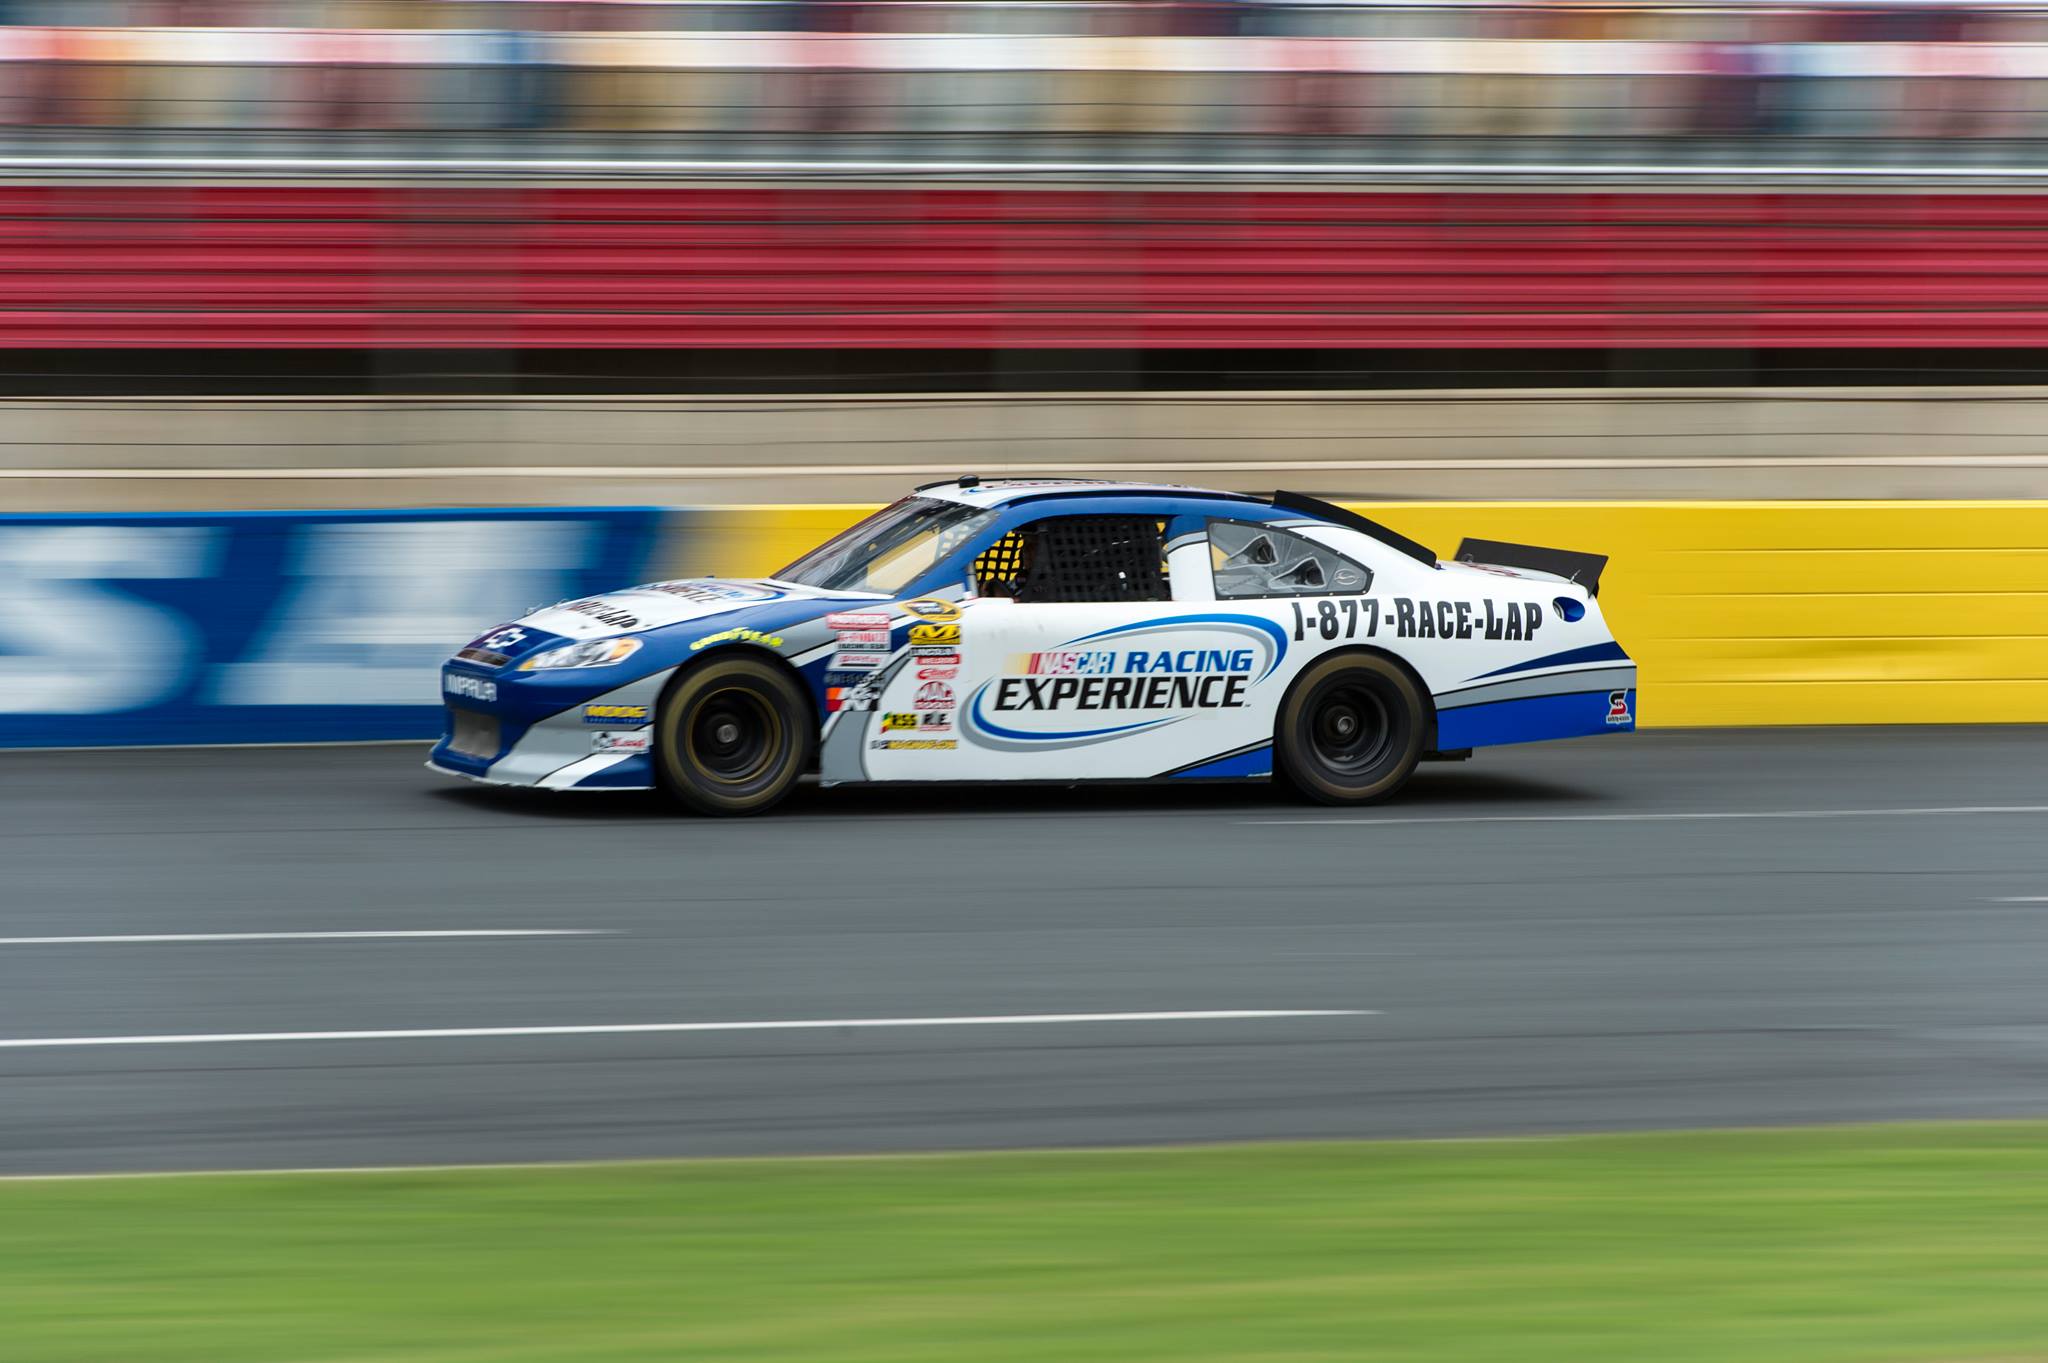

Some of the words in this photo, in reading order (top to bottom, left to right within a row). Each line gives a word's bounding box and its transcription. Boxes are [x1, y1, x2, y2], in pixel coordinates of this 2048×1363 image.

[1292, 596, 1543, 642] 1-877-RACE-LAP
[689, 626, 784, 651] GOODYEAR
[1029, 651, 1116, 675] NASCAR
[1123, 650, 1254, 674] RACING
[994, 675, 1249, 711] EXPERIENCE
[585, 705, 649, 718] MOOG
